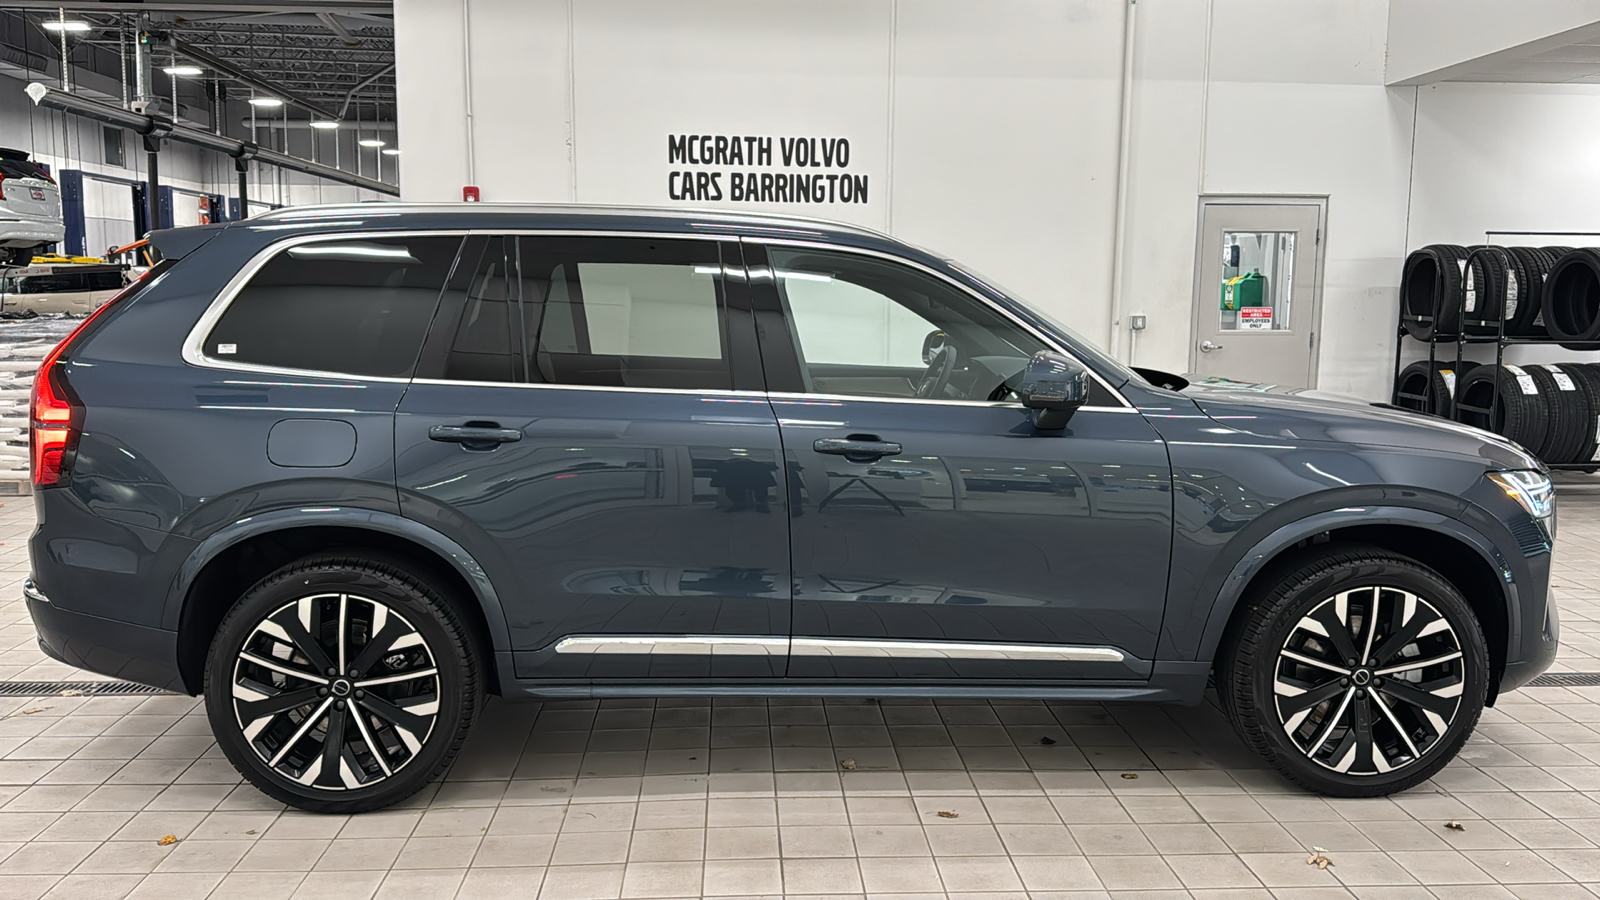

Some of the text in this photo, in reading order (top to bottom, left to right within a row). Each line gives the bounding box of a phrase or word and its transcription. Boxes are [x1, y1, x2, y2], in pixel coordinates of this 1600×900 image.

[668, 134, 850, 168] MCGRATH VOLVO
[669, 171, 868, 204] CARS BARRINGTON
